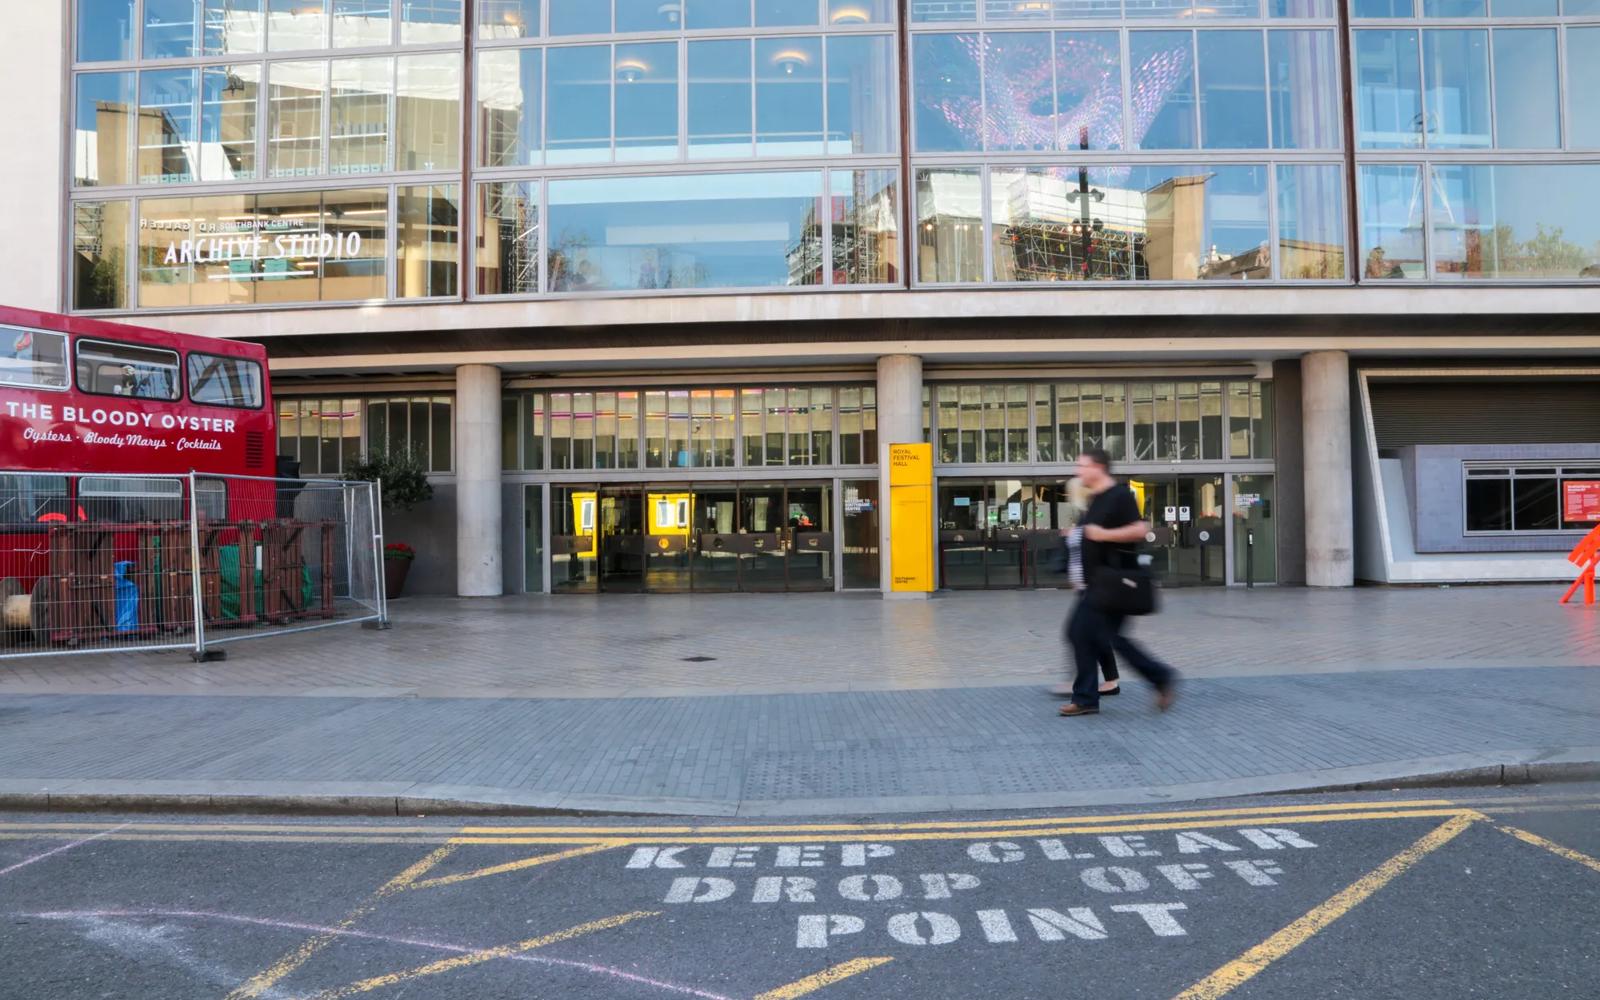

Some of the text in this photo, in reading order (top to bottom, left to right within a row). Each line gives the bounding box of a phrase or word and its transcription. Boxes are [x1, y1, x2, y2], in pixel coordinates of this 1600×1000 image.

[219, 220, 270, 230] SOUTHBANK
[271, 218, 304, 228] CENTRE
[164, 231, 361, 264] ARCHIVE STUDIO
[6, 401, 235, 432] THE BLOODY OYSTER
[23, 427, 222, 452] Oysters Bloody Marys Cocktails
[624, 827, 1319, 869] KEEP CLEAR
[662, 859, 1288, 904] DROP OFF
[796, 901, 1190, 949] POINT
